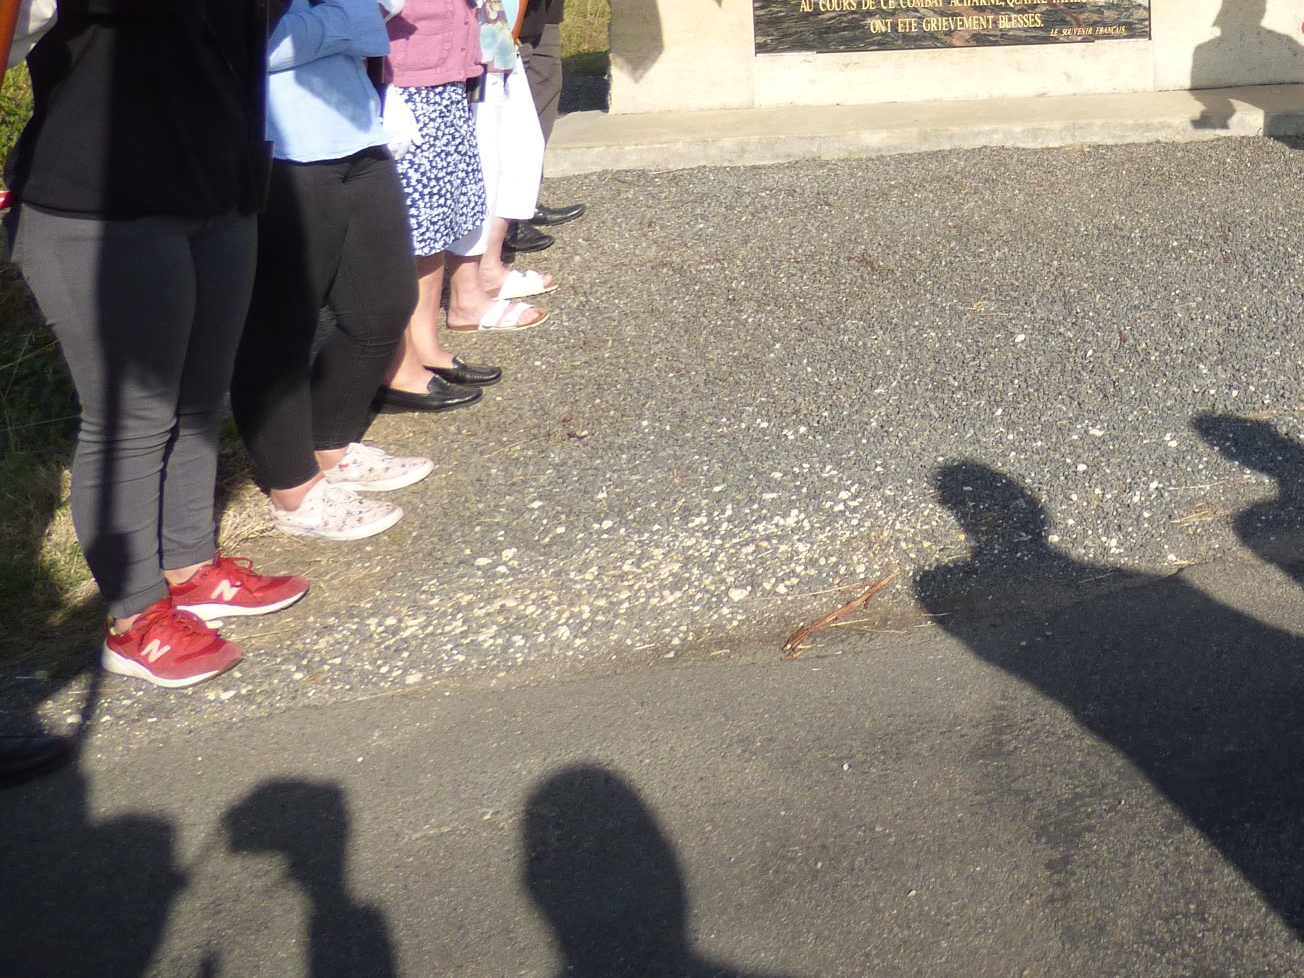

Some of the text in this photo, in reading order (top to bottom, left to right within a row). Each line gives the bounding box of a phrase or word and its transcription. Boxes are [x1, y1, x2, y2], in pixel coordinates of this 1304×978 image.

[870, 20, 892, 34] ONT
[898, 18, 918, 33] ETE
[922, 15, 995, 32] GRIEVEMENT
[1062, 27, 1093, 36] SOUVENIR
[211, 580, 240, 601] N
[140, 639, 171, 663] N
